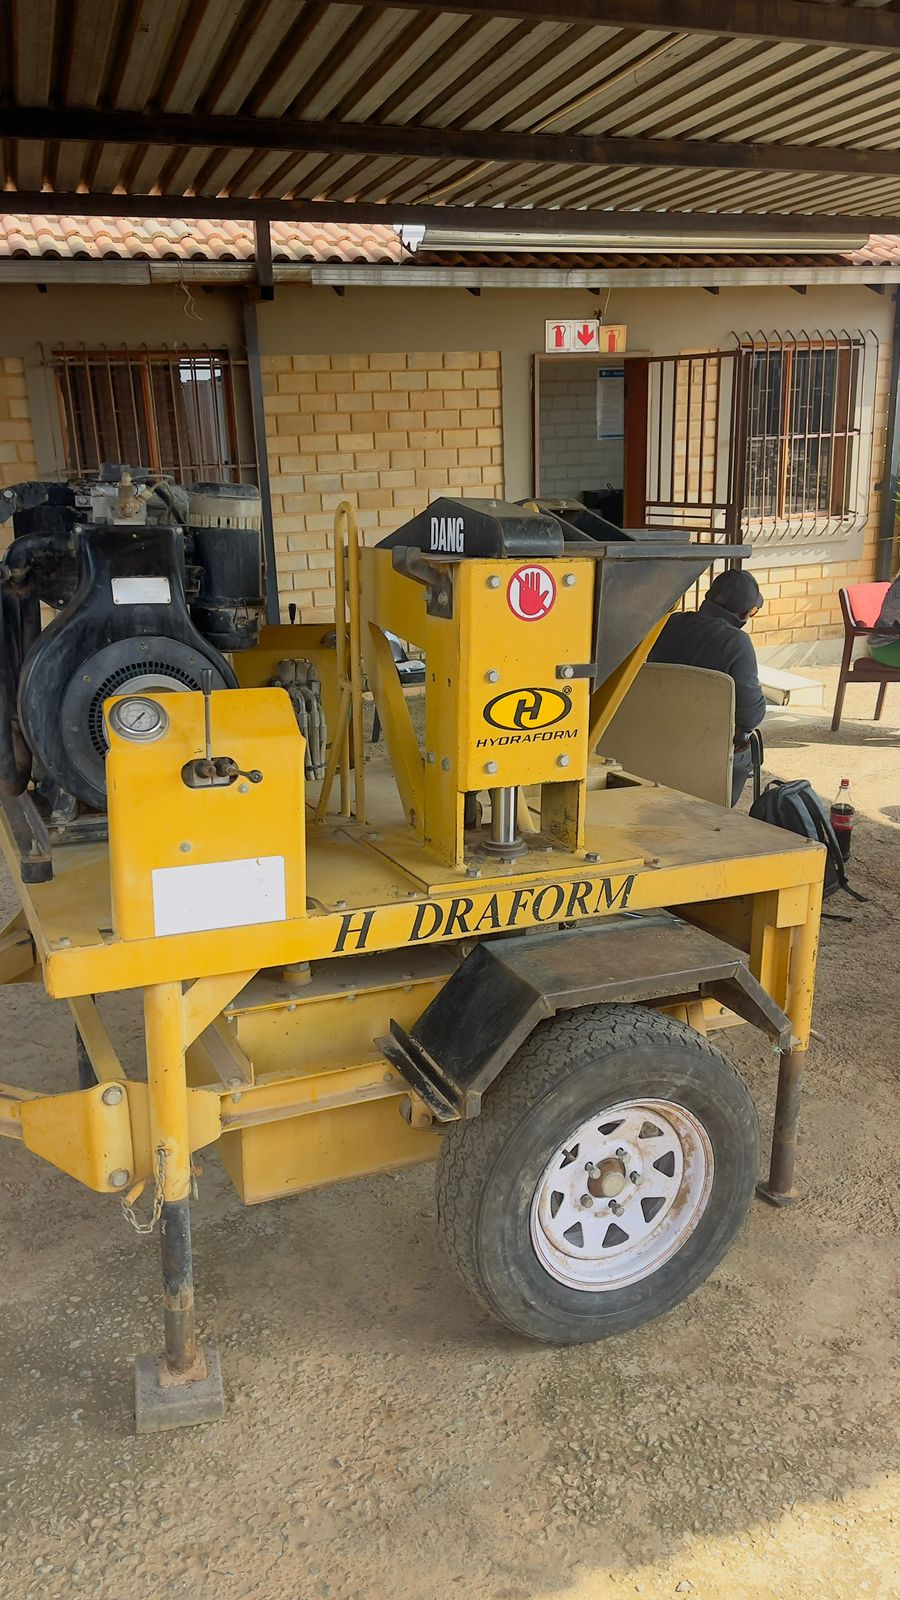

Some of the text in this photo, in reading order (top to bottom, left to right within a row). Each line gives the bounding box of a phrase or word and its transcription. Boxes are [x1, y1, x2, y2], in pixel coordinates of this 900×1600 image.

[430, 517, 464, 553] DANG
[476, 729, 578, 748] HYDRAFORM
[407, 874, 638, 942] DRAFORM
